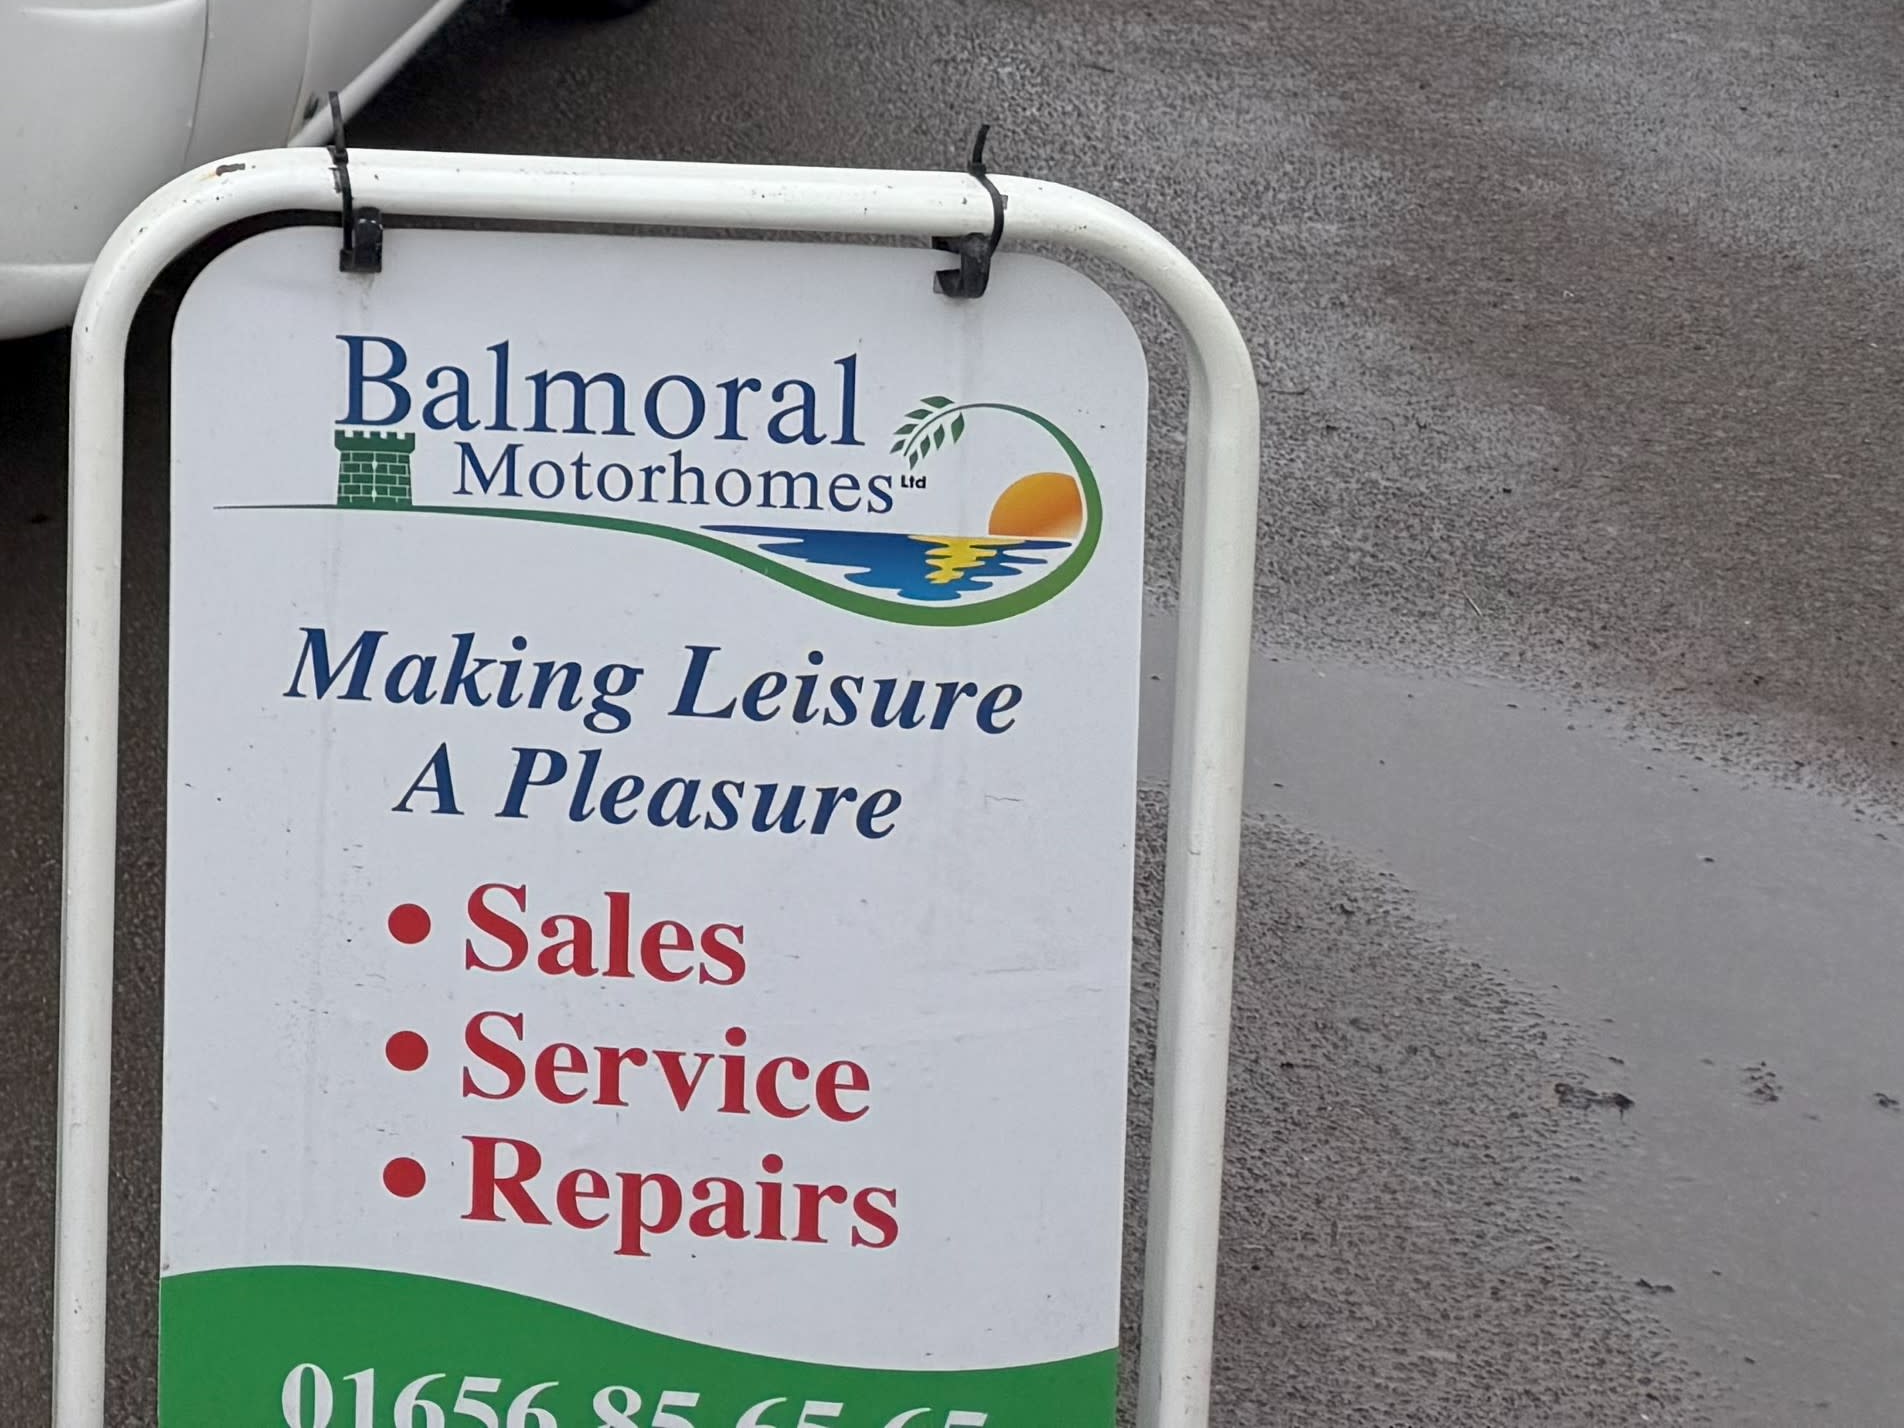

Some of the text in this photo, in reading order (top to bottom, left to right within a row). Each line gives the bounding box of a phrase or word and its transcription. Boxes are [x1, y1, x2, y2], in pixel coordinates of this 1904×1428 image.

[334, 334, 866, 447] Balmoral
[452, 441, 927, 514] Motorhomes Ltd
[282, 627, 1023, 735] Making Leisure
[391, 741, 902, 840] A Pleasure
[465, 882, 747, 986] Sales
[463, 1010, 870, 1122] Service
[463, 1136, 899, 1257] Repairs
[281, 1362, 560, 1428] 01656
